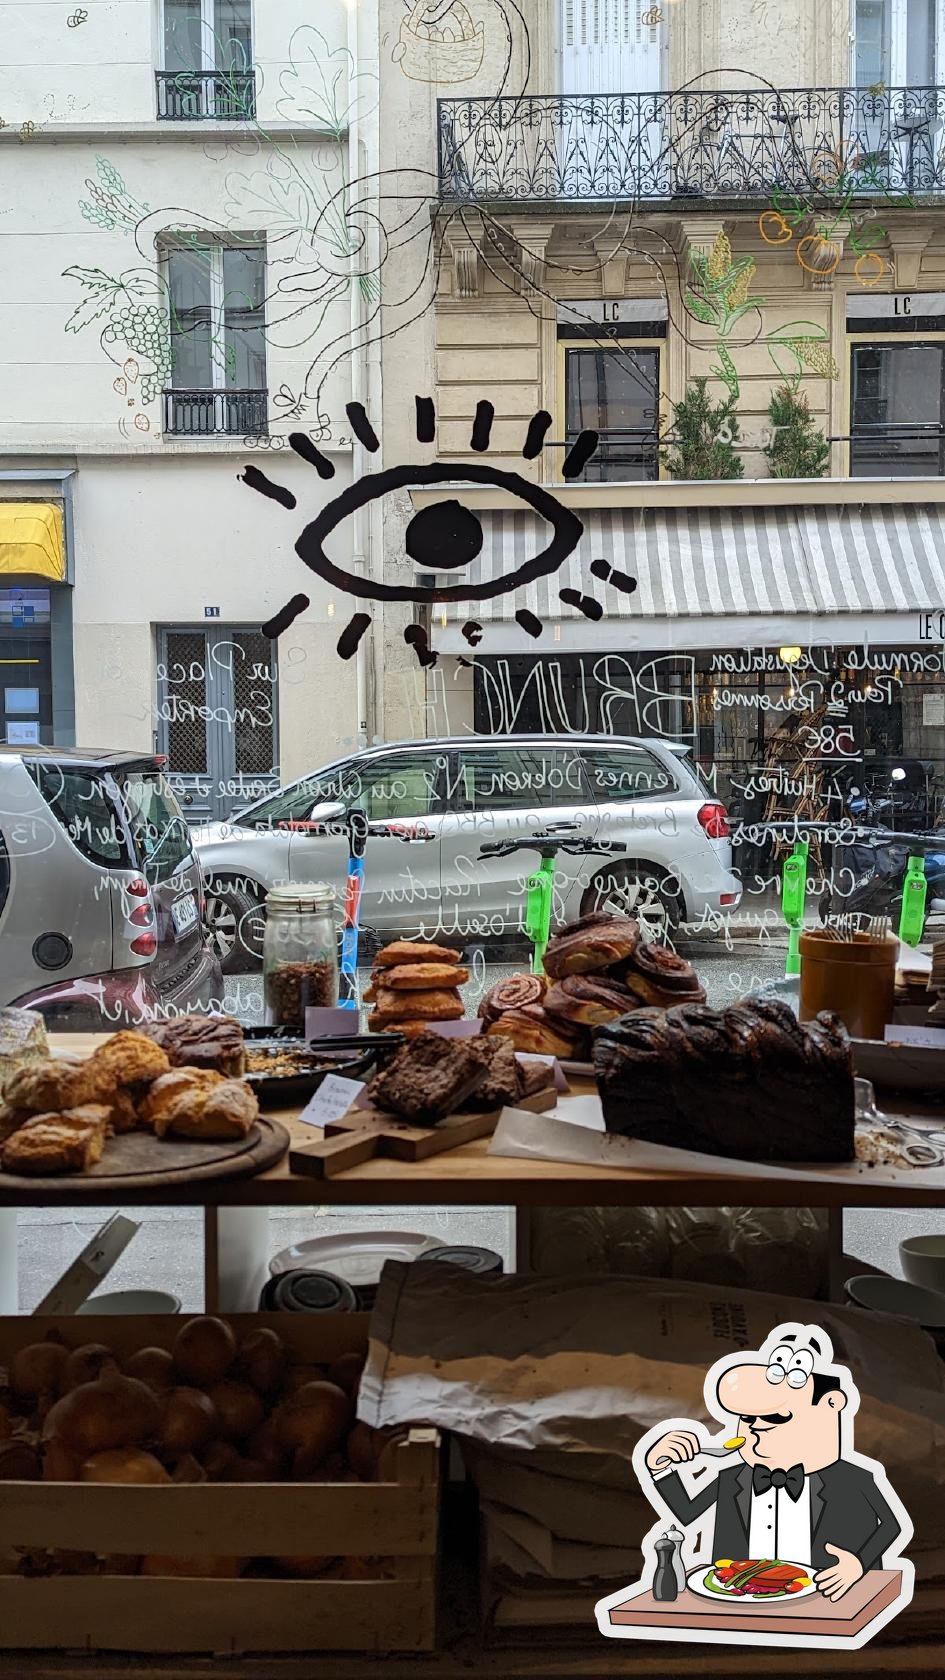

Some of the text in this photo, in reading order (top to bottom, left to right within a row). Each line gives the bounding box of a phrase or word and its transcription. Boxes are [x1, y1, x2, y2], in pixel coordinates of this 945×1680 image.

[603, 302, 619, 321] LC
[894, 297, 911, 315] LC
[919, 614, 933, 640] LE
